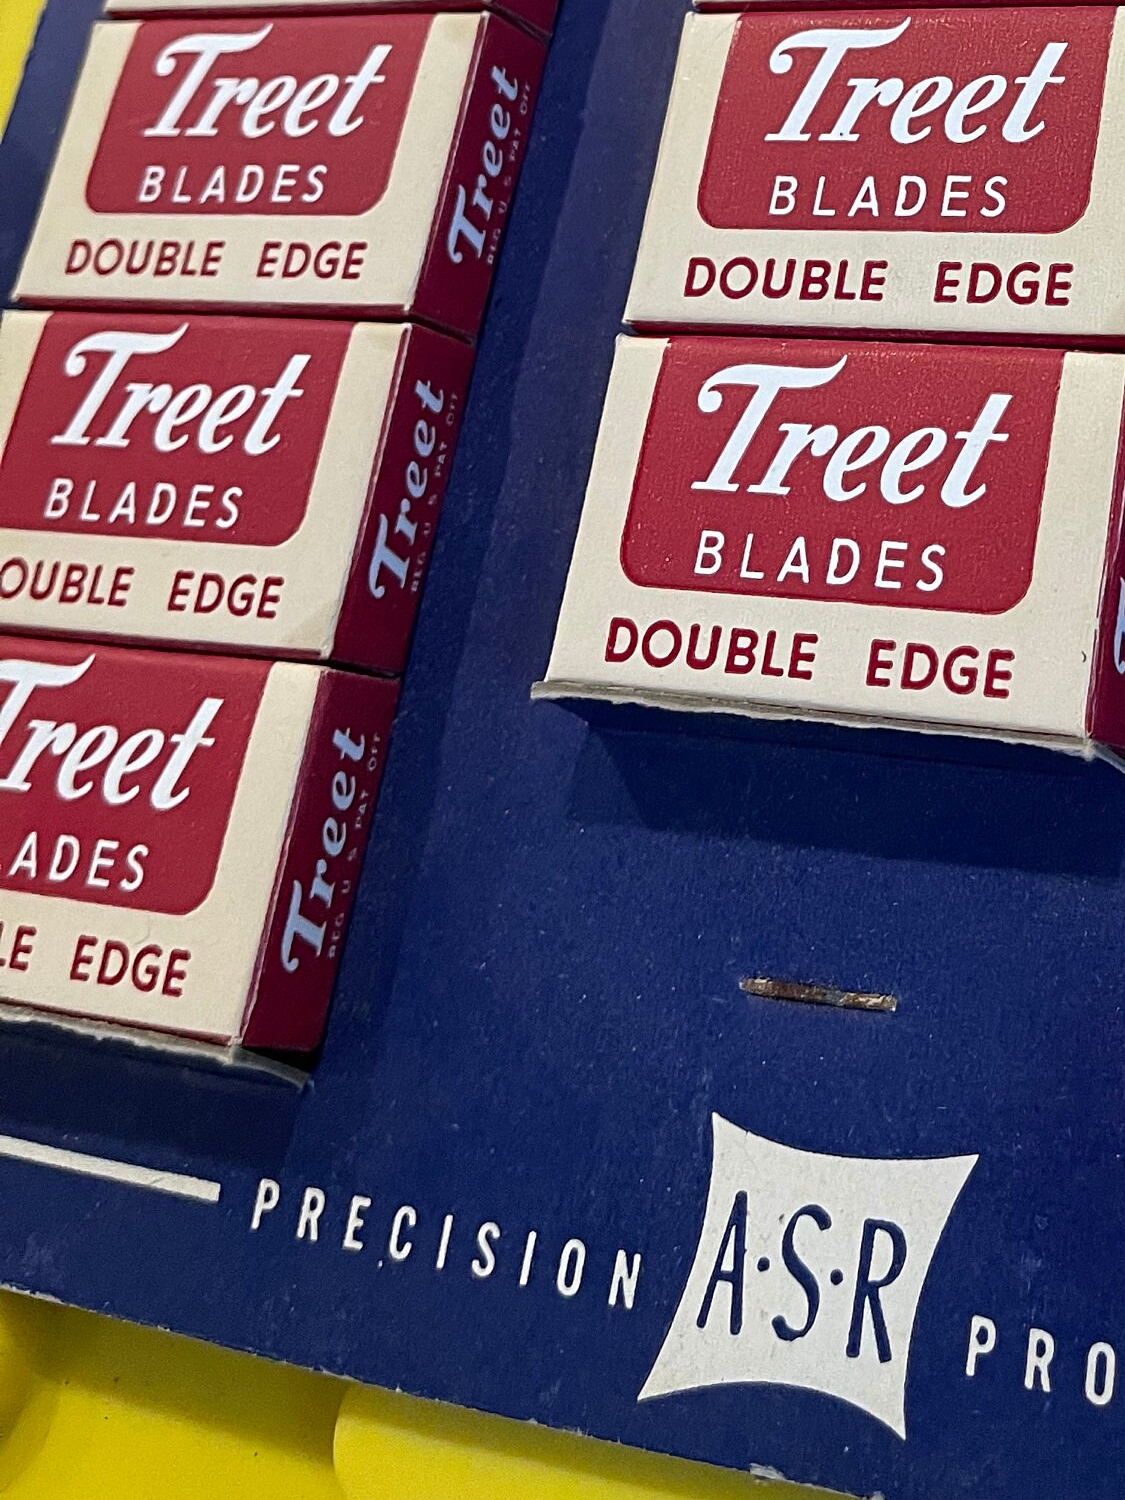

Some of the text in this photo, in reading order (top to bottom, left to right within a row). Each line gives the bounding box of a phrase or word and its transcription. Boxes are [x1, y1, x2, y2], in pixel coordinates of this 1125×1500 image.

[144, 24, 392, 138] Treet
[765, 17, 1068, 144] Treet
[139, 165, 327, 203] BLADES
[448, 66, 517, 263] Treet
[769, 175, 1007, 217] BLADES
[65, 239, 367, 279] DOUBLE EDGE
[684, 257, 1073, 306] DOUBLE EDGE
[51, 323, 311, 455] Treet
[691, 355, 1012, 507] Treet
[44, 478, 242, 528] BLADES
[369, 380, 445, 597] Treet
[0, 558, 284, 618] OUBLE EDGE
[694, 530, 945, 591] BLADES
[605, 617, 1015, 698] DOUBLE EDGE
[0, 654, 223, 810] Treet
[0, 832, 148, 891] ADES
[282, 728, 366, 971] Treet
[70, 935, 191, 997] EDGE
[251, 1179, 641, 1309] PRECISION
